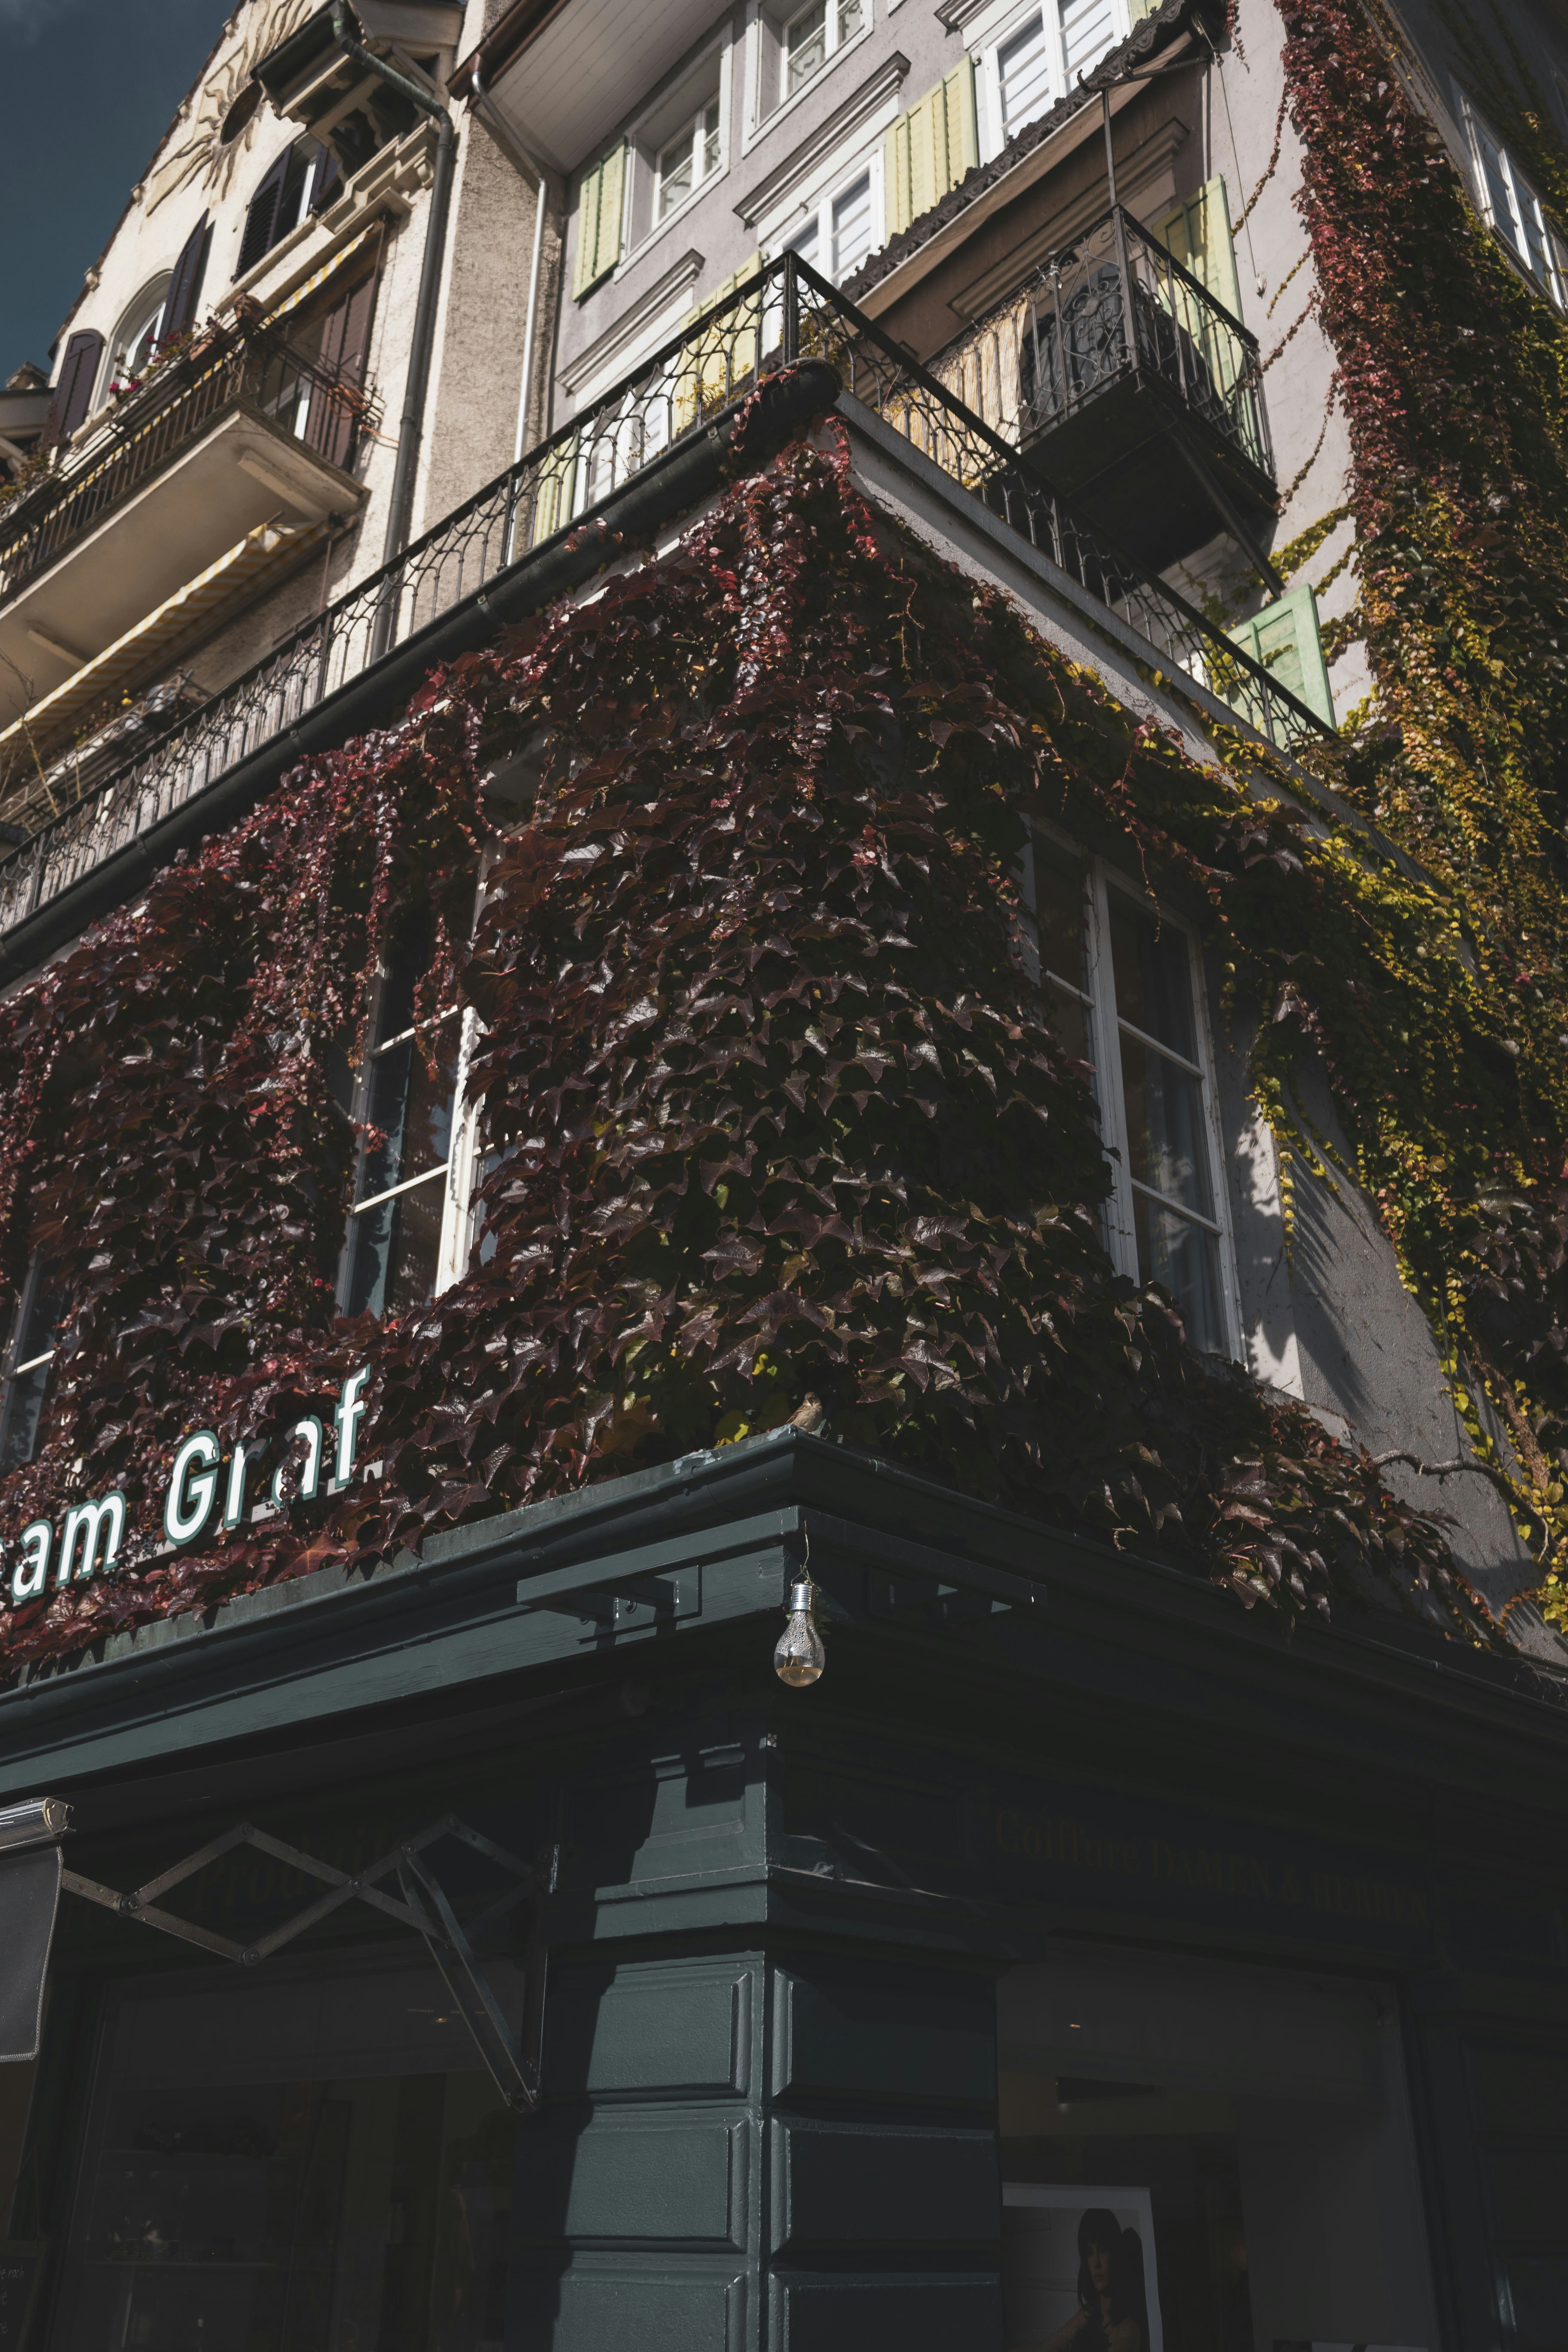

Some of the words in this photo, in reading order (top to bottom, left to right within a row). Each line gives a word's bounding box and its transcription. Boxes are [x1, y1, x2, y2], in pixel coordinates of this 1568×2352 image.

[11, 1491, 126, 1602] am
[164, 1364, 371, 1545] Graf
[188, 1826, 401, 1914] Produit
[995, 1809, 1139, 1874] Coiffure
[1150, 1839, 1272, 1898] DAMEN
